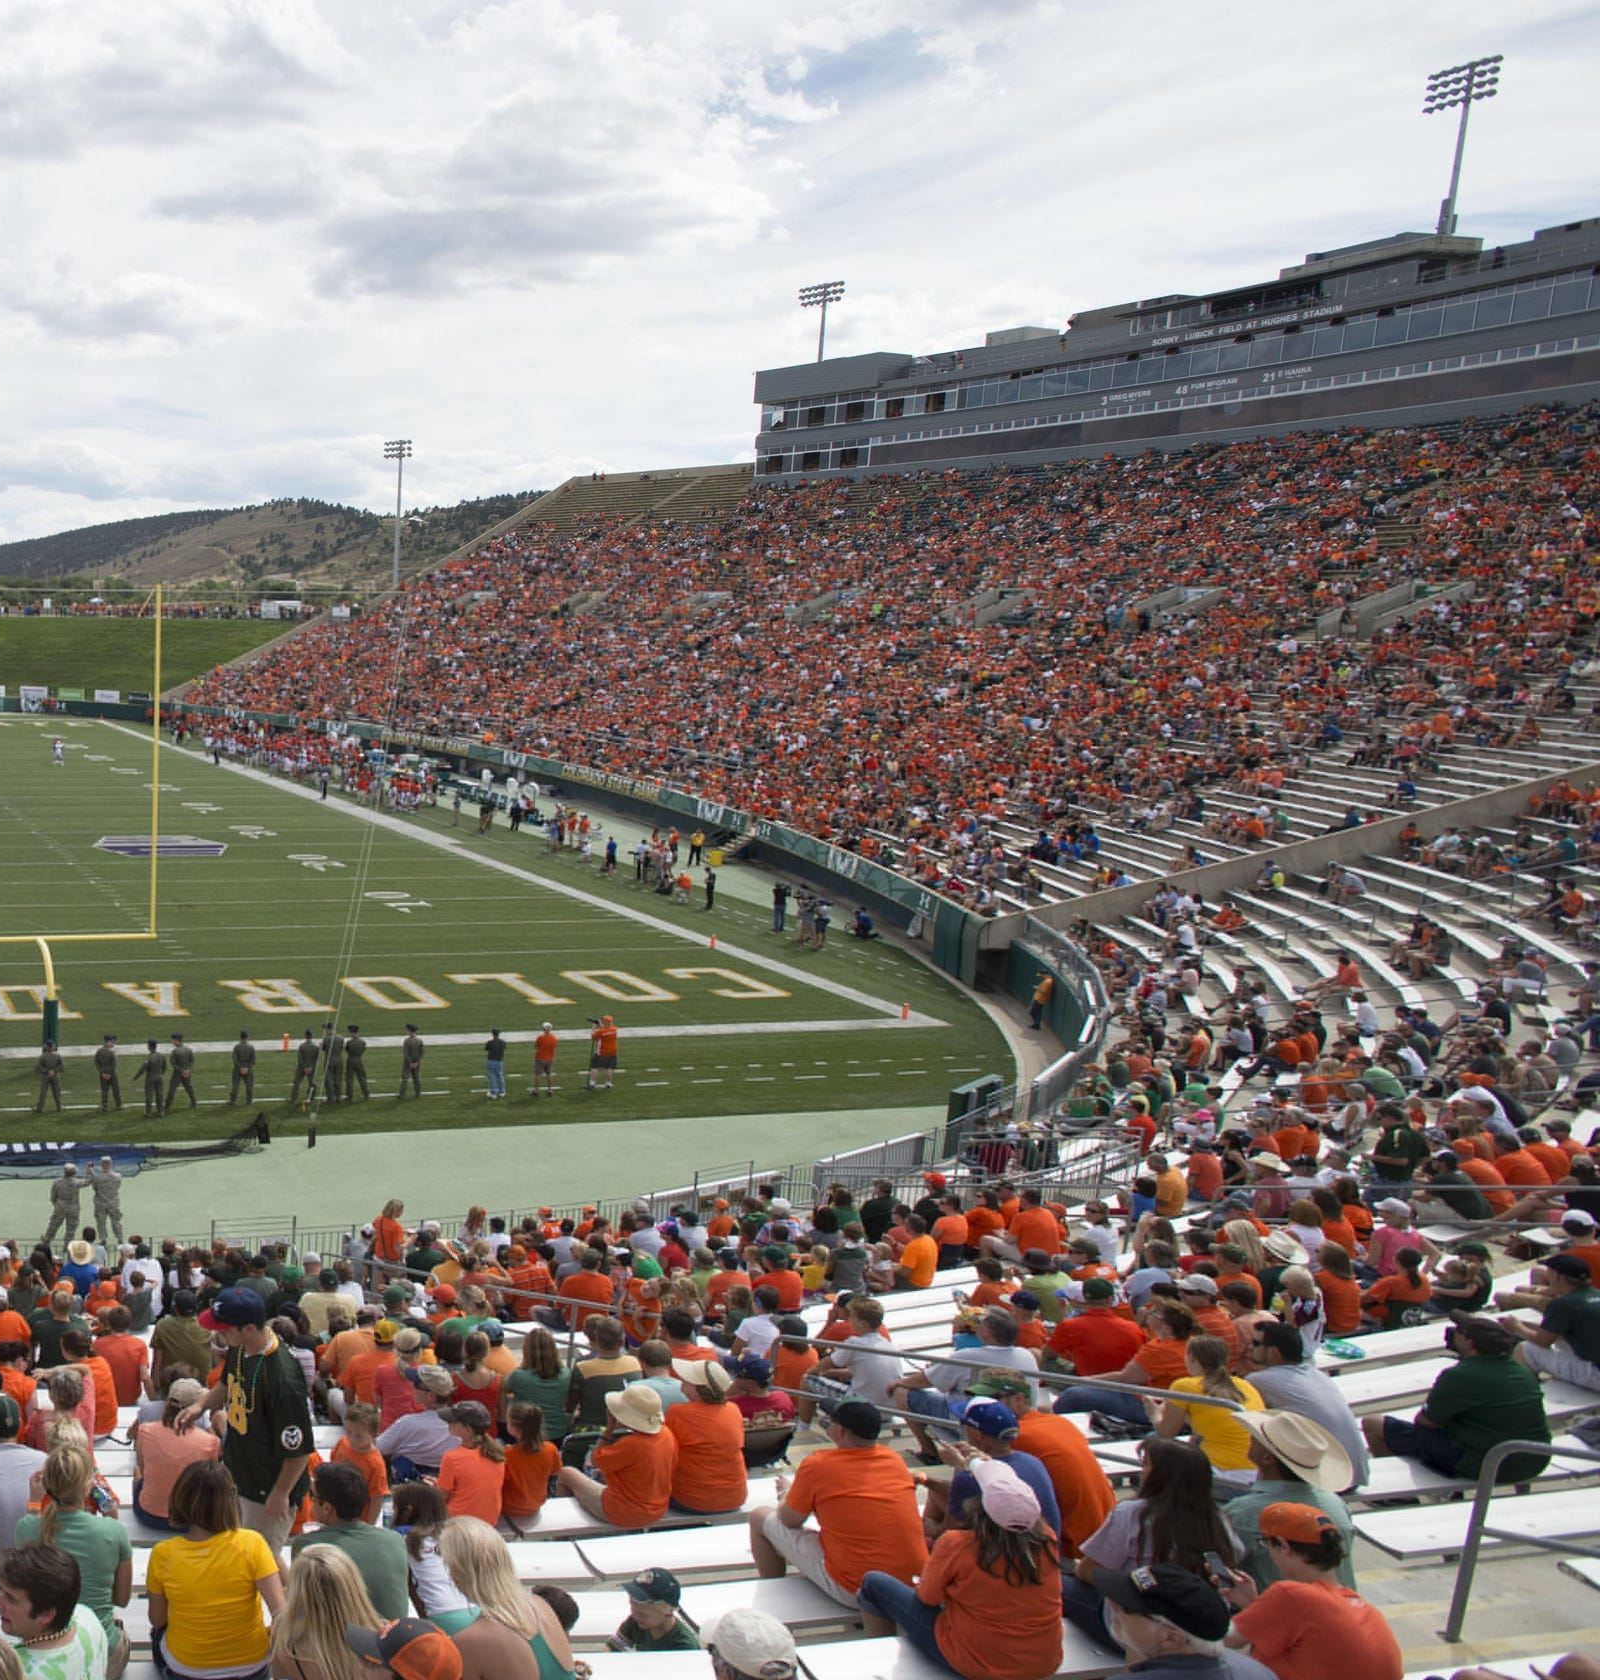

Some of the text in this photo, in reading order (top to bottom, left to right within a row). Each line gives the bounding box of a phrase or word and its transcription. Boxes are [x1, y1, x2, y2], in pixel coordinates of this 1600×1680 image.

[1151, 304, 1344, 347] SONNY LUBICK FIELD AT HUGHES STADIUM
[1261, 372, 1276, 383] 21
[1175, 385, 1188, 395] 48
[1101, 389, 1152, 406] 3 GREG MYERS
